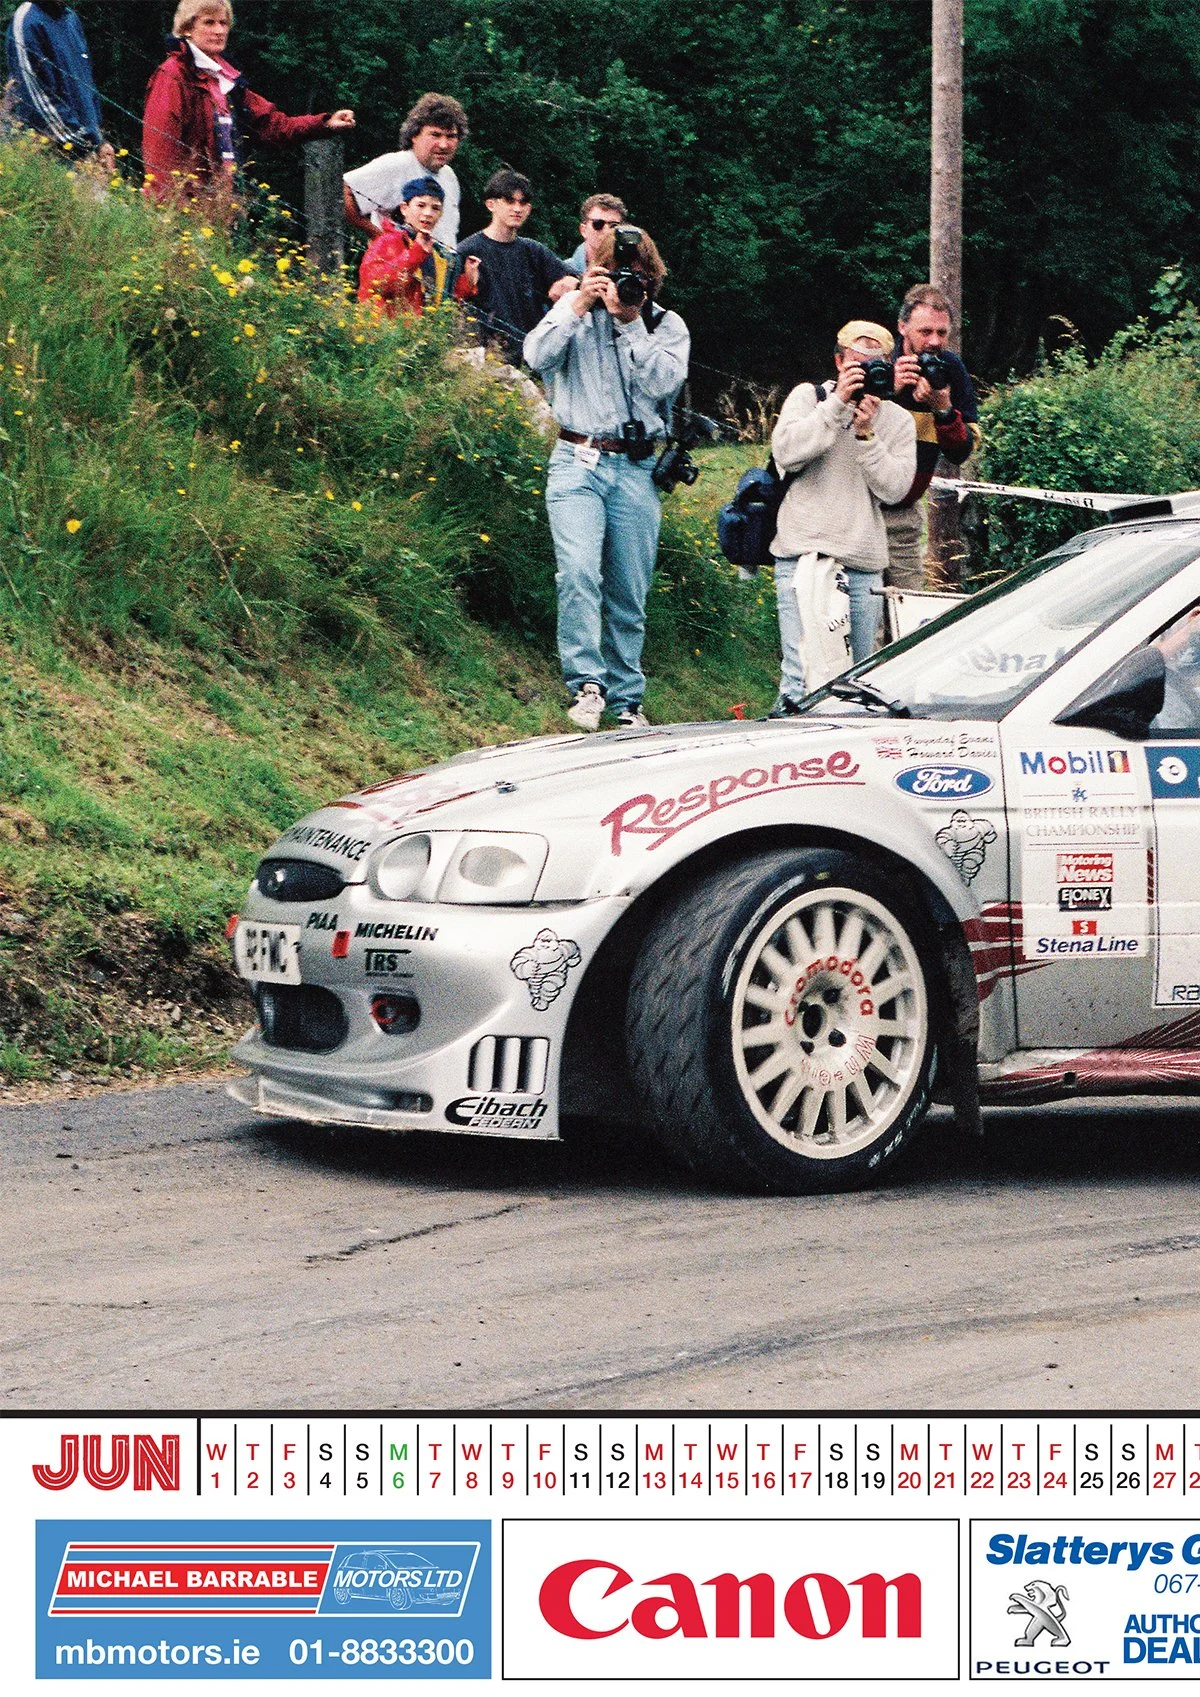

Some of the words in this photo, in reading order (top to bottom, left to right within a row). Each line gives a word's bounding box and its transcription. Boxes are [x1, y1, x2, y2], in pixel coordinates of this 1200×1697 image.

[1020, 751, 1104, 774] Mobil
[912, 769, 973, 793] Ford
[601, 750, 862, 856] Response
[1024, 807, 1083, 819] BRITISH
[1089, 806, 1137, 818] RALLY
[1026, 824, 1140, 836] CHAMPIONSHIP
[1060, 855, 1112, 867] Motoring
[1060, 865, 1112, 882] News
[306, 912, 339, 931] PIAA
[354, 922, 439, 941] MICHELIN
[1036, 937, 1094, 953] Stena
[1097, 936, 1138, 952] Line
[445, 1096, 548, 1126] Eibach
